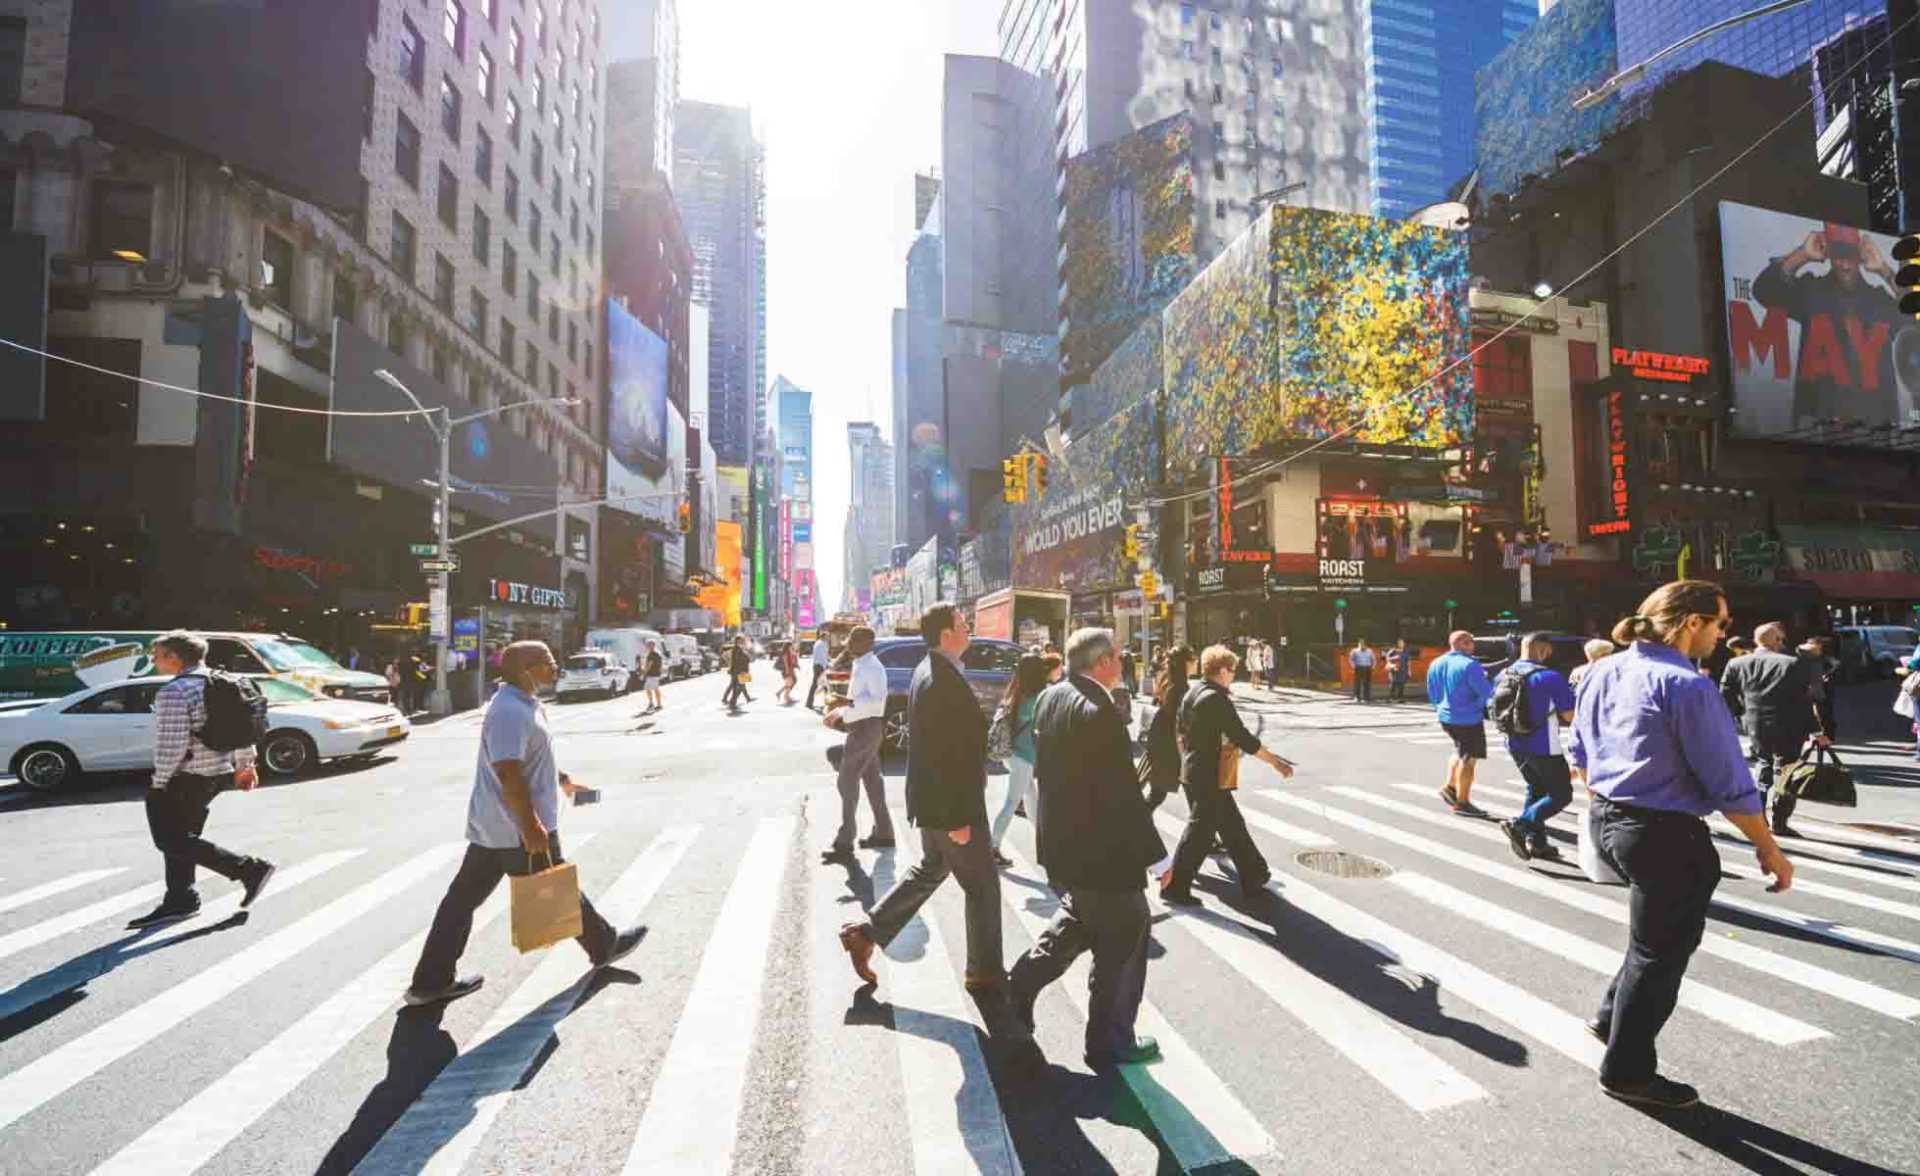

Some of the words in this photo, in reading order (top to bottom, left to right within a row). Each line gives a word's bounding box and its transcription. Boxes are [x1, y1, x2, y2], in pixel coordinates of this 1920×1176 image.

[1733, 277, 1752, 300] THE
[1025, 524, 1060, 556] WOULD
[1062, 510, 1087, 542] YOU
[1088, 496, 1123, 534] EVER
[1198, 568, 1225, 586] ROAST
[1319, 559, 1366, 577] ROAST
[489, 579, 498, 600] I
[508, 582, 529, 603] NY
[531, 587, 566, 609] GIFTS
